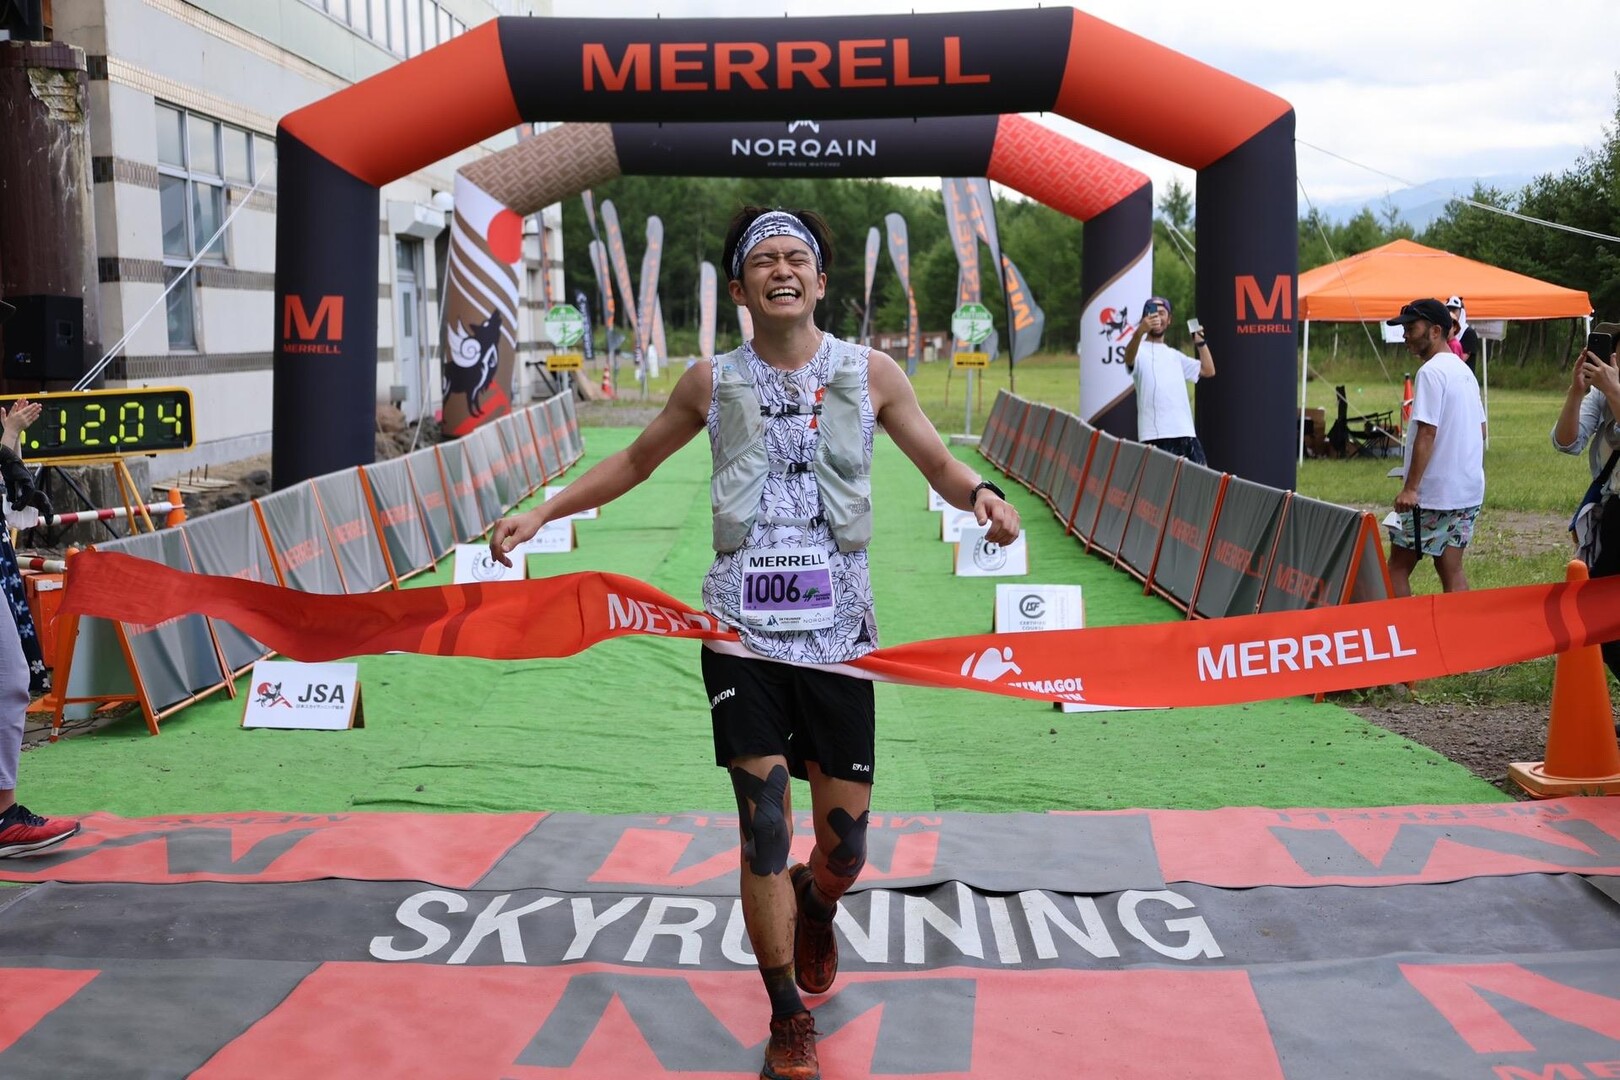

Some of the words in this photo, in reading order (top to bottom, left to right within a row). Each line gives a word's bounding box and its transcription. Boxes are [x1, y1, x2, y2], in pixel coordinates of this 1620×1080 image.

[582, 36, 991, 91] MERRELL
[731, 138, 876, 158] NORQAIN
[1235, 274, 1292, 320] M
[284, 294, 344, 340] M
[1237, 323, 1292, 334] MERRELL
[283, 343, 342, 354] MERRELL
[1102, 346, 1126, 365] JS
[749, 553, 826, 568] MERRELL
[745, 573, 801, 604] 1006
[1025, 602, 1041, 612] ISF
[1197, 625, 1418, 682] MERRELL
[298, 684, 345, 703] JSA
[369, 881, 1225, 965] SKYRUNNING
